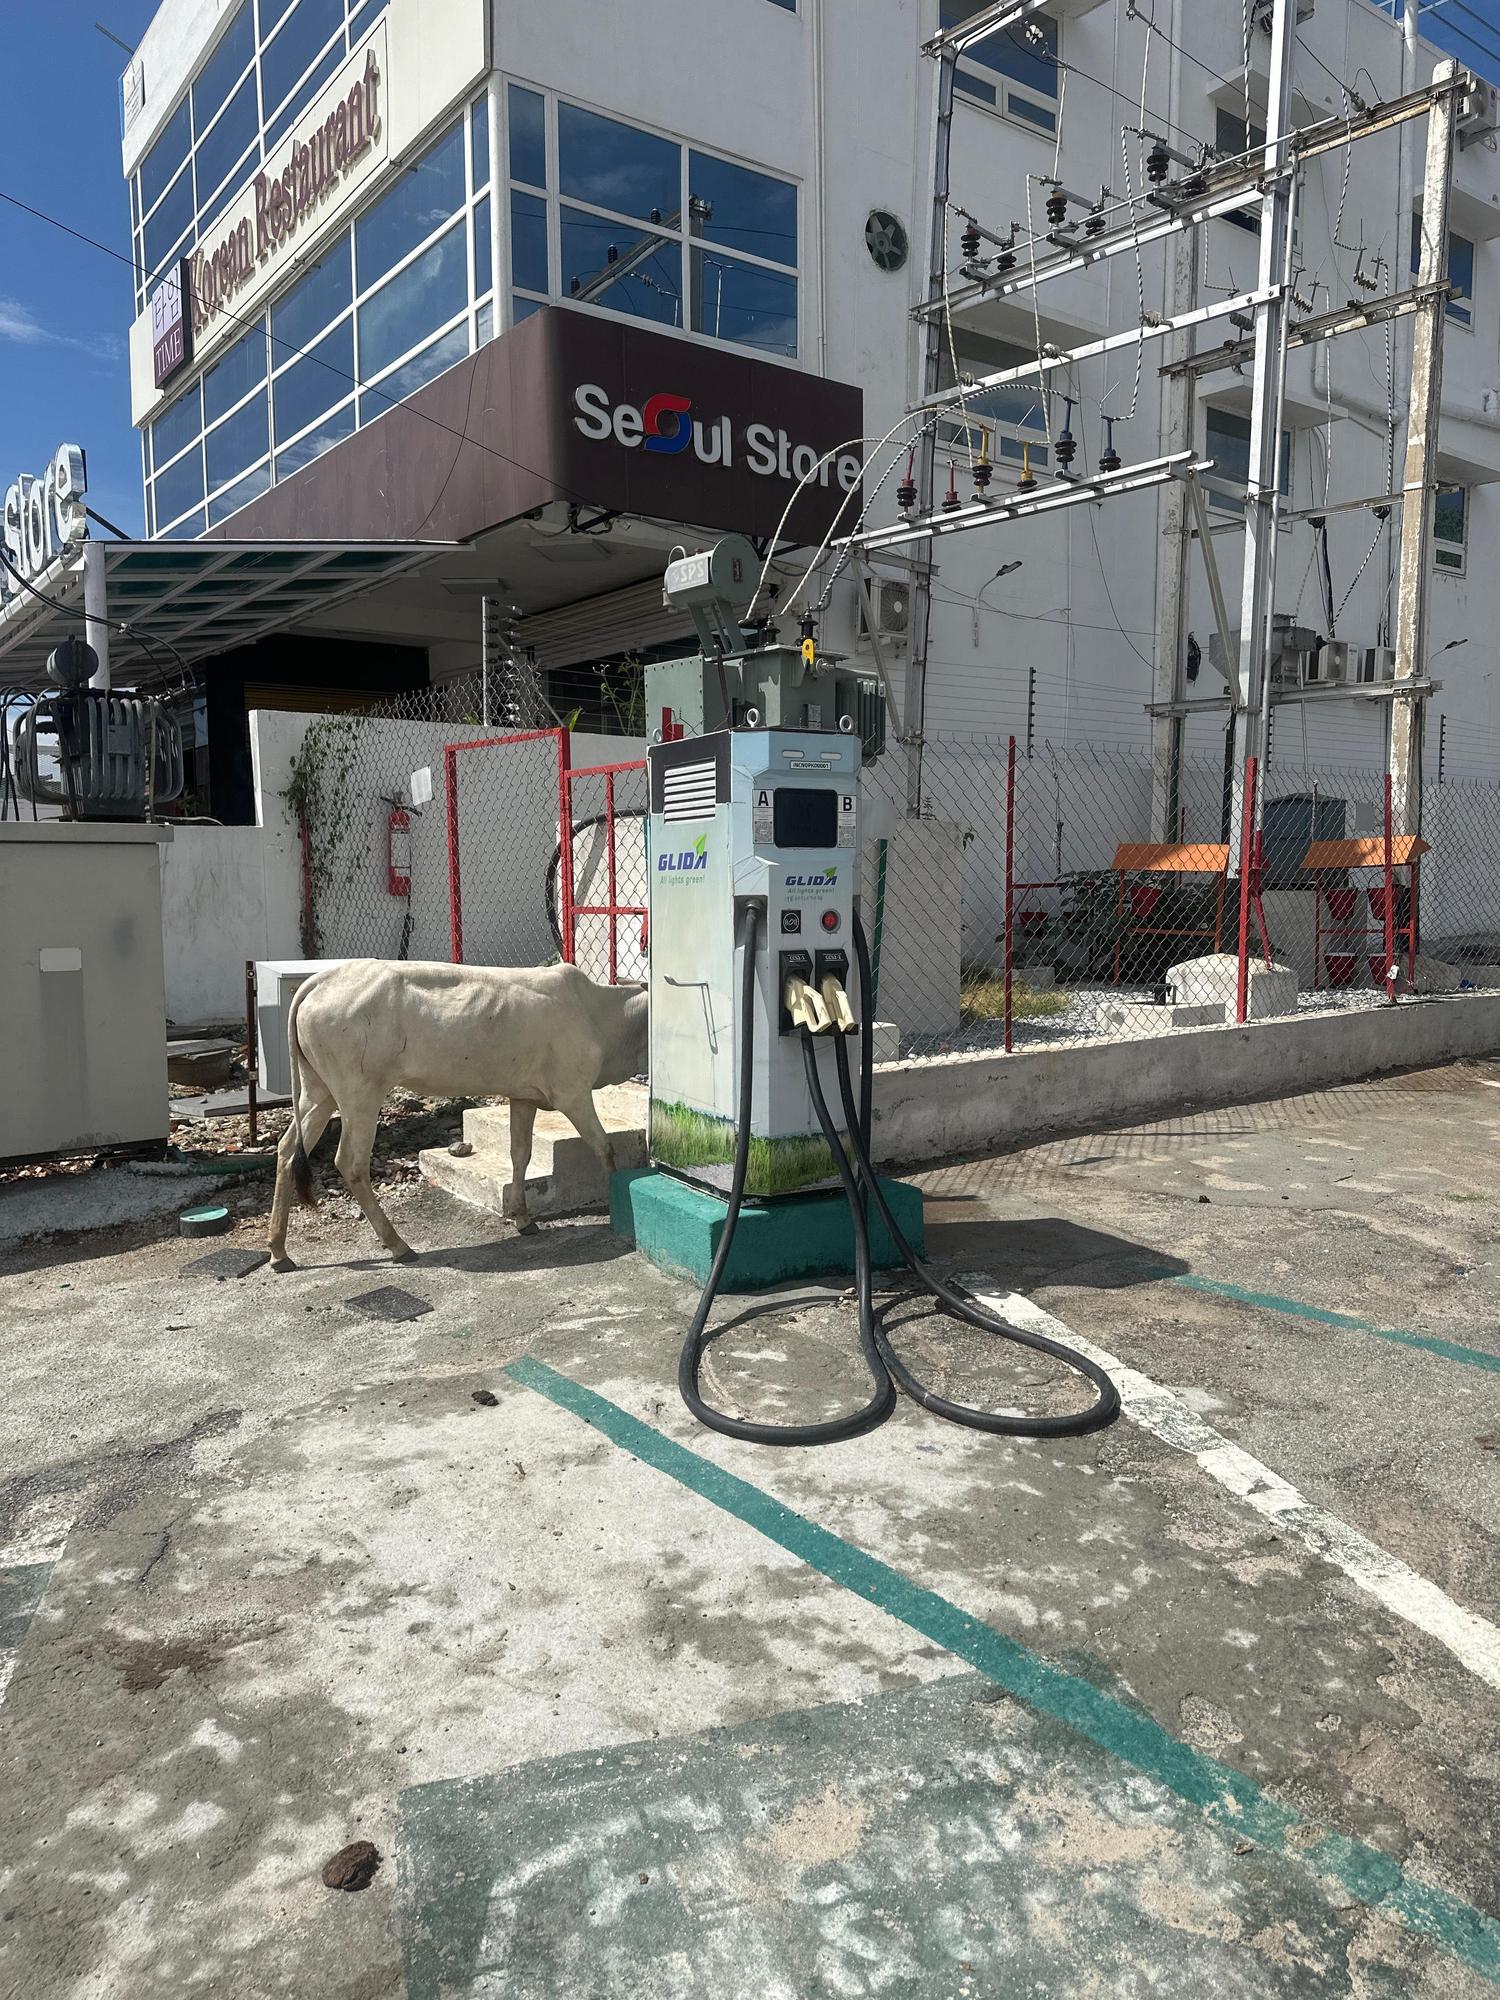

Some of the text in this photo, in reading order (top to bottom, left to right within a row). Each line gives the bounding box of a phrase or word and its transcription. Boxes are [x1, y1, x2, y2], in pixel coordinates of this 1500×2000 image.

[189, 48, 381, 338] Korean Restaurant
[154, 267, 180, 332] 타임
[156, 328, 182, 377] TIME
[746, 423, 863, 493] Store
[4, 442, 86, 594] Store
[758, 791, 769, 807] A
[843, 796, 853, 812] B
[658, 848, 708, 871] GLIDA
[785, 873, 838, 886] GLIDA
